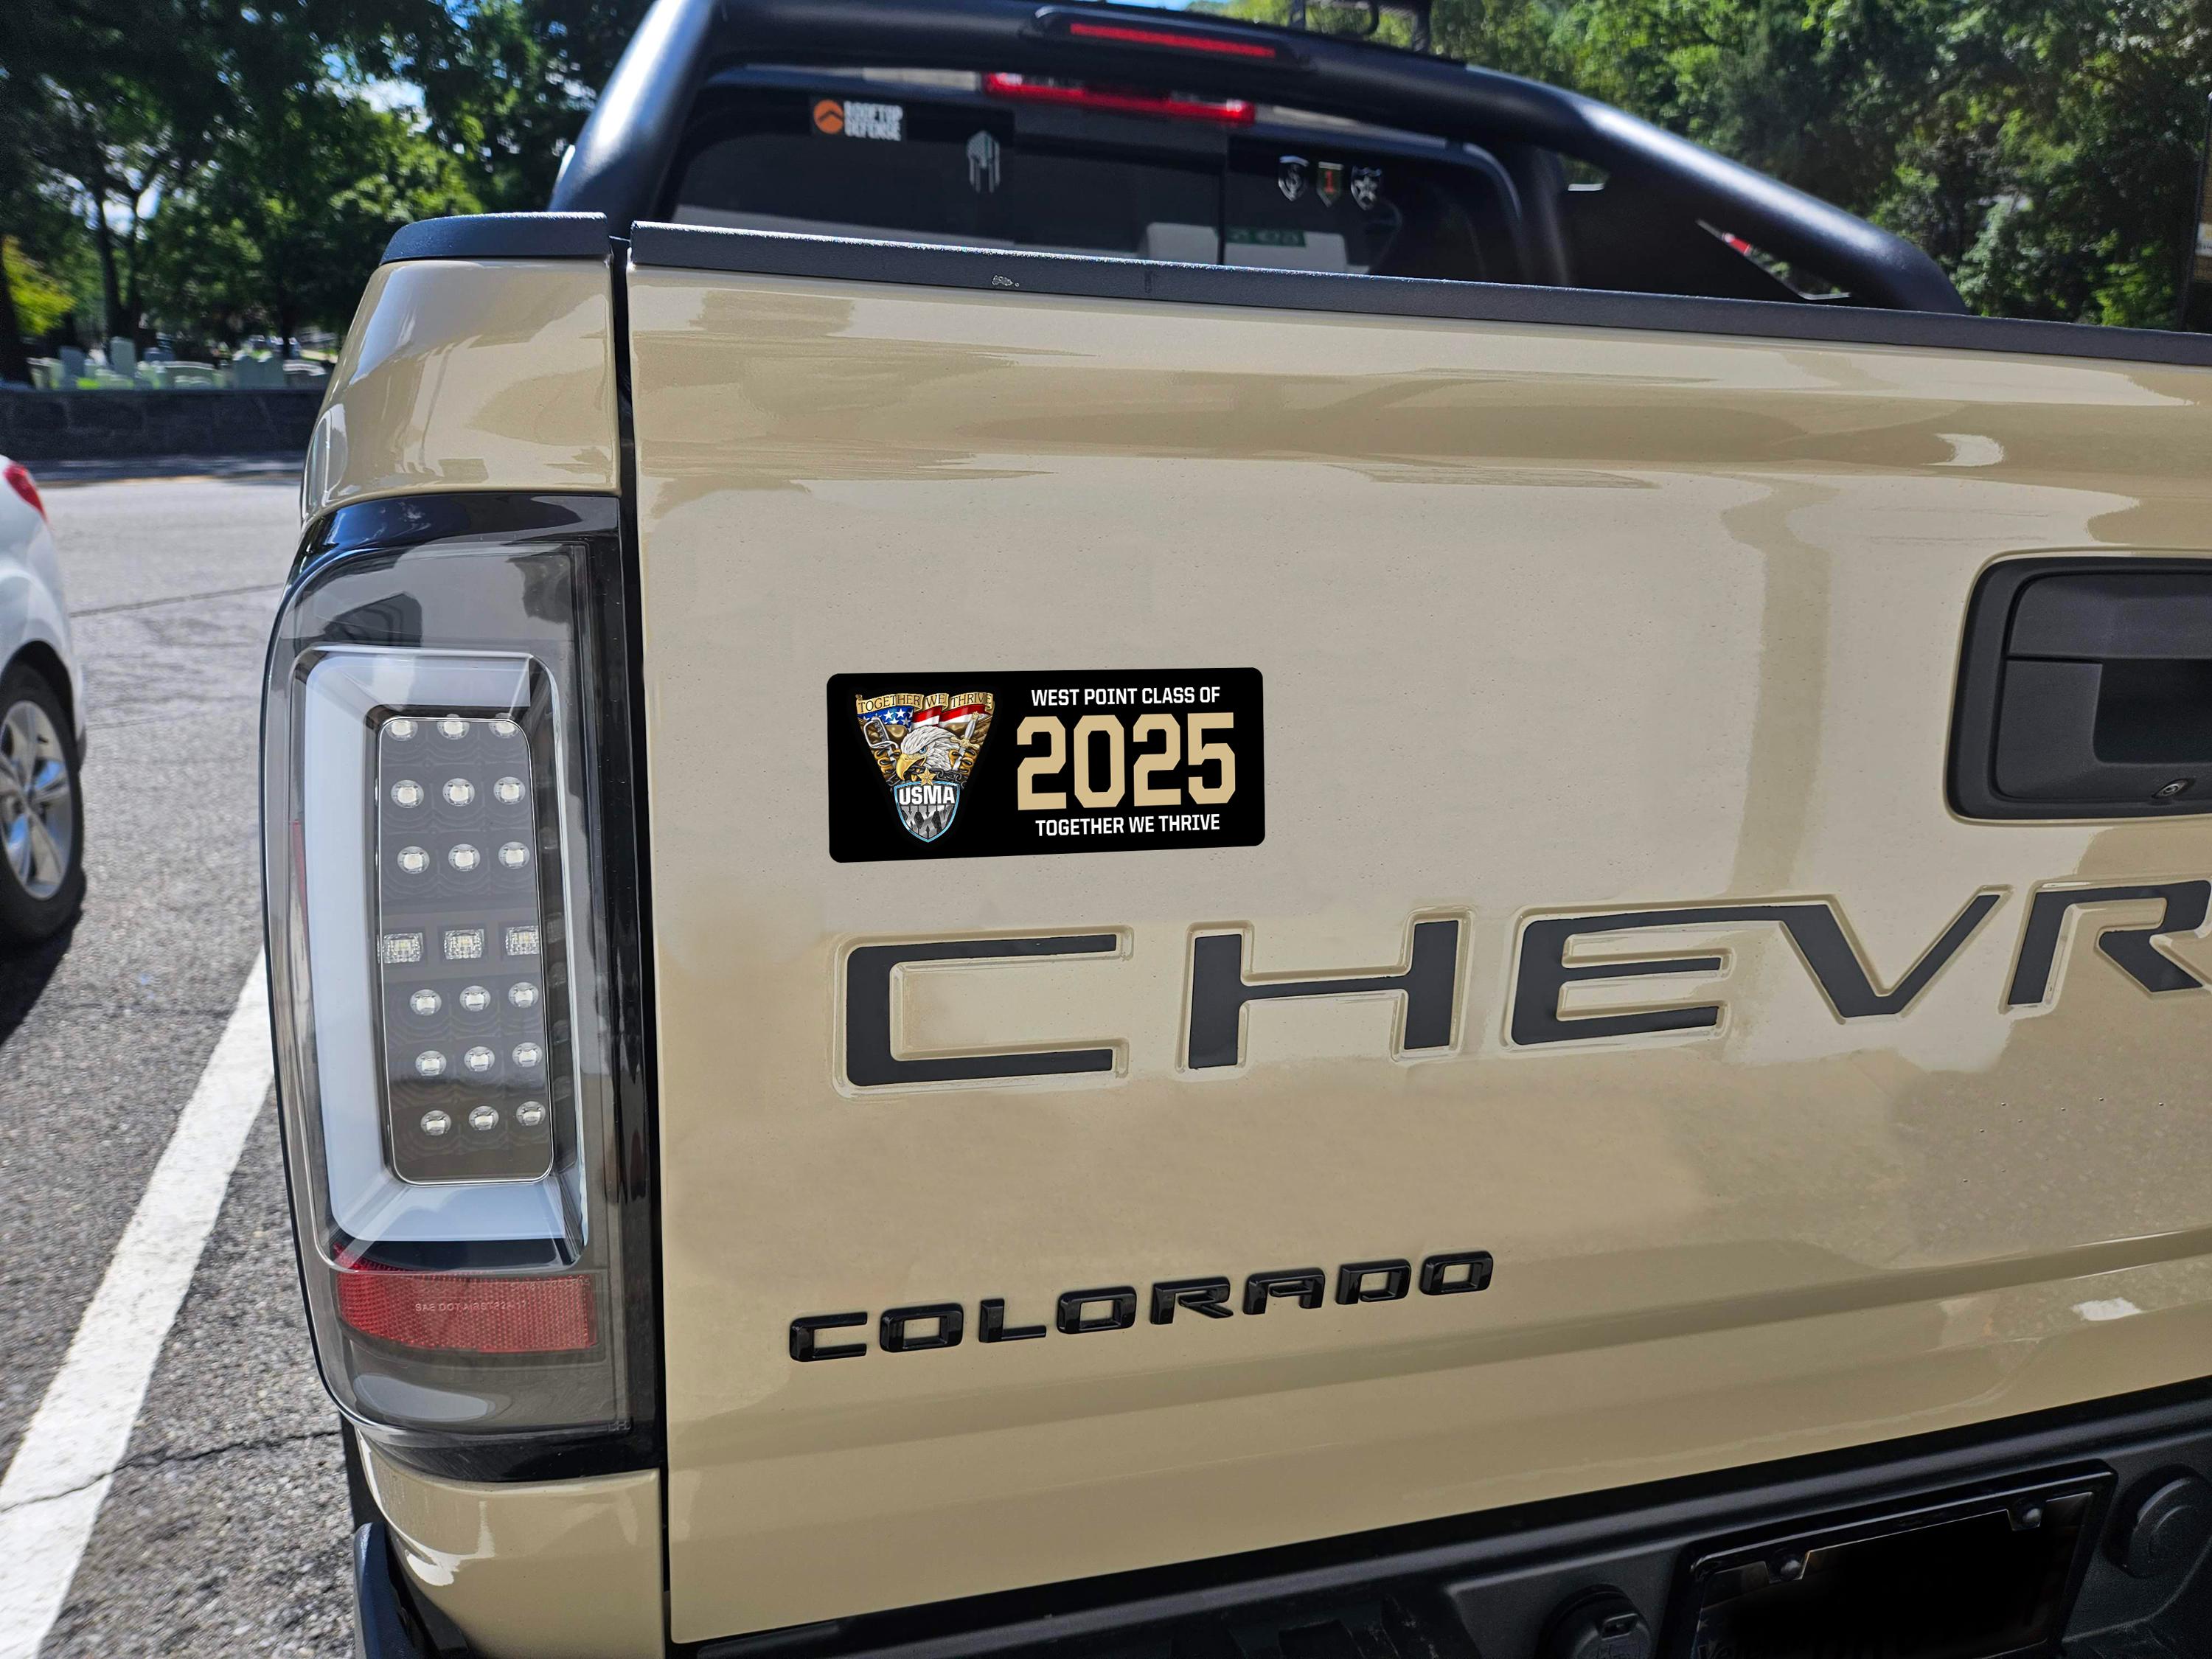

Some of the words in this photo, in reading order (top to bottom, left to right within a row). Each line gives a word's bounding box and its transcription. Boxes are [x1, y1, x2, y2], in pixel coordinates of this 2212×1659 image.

[858, 694, 921, 713] TOGETHER
[925, 694, 946, 708] WE
[951, 692, 992, 708] THRIVE
[1031, 689, 1079, 706] WEST
[1084, 688, 1138, 706] POINT
[1141, 686, 1195, 704] CLASS
[1199, 686, 1220, 703] OF
[1016, 712, 1236, 810] 2025
[899, 785, 956, 805] USMA
[1035, 817, 1124, 837] TOGETHER
[1128, 815, 1155, 833] WE
[1158, 813, 1220, 832] THRIVE
[845, 879, 2212, 1088] CHEVR
[789, 1249, 1495, 1363] COLORADO
